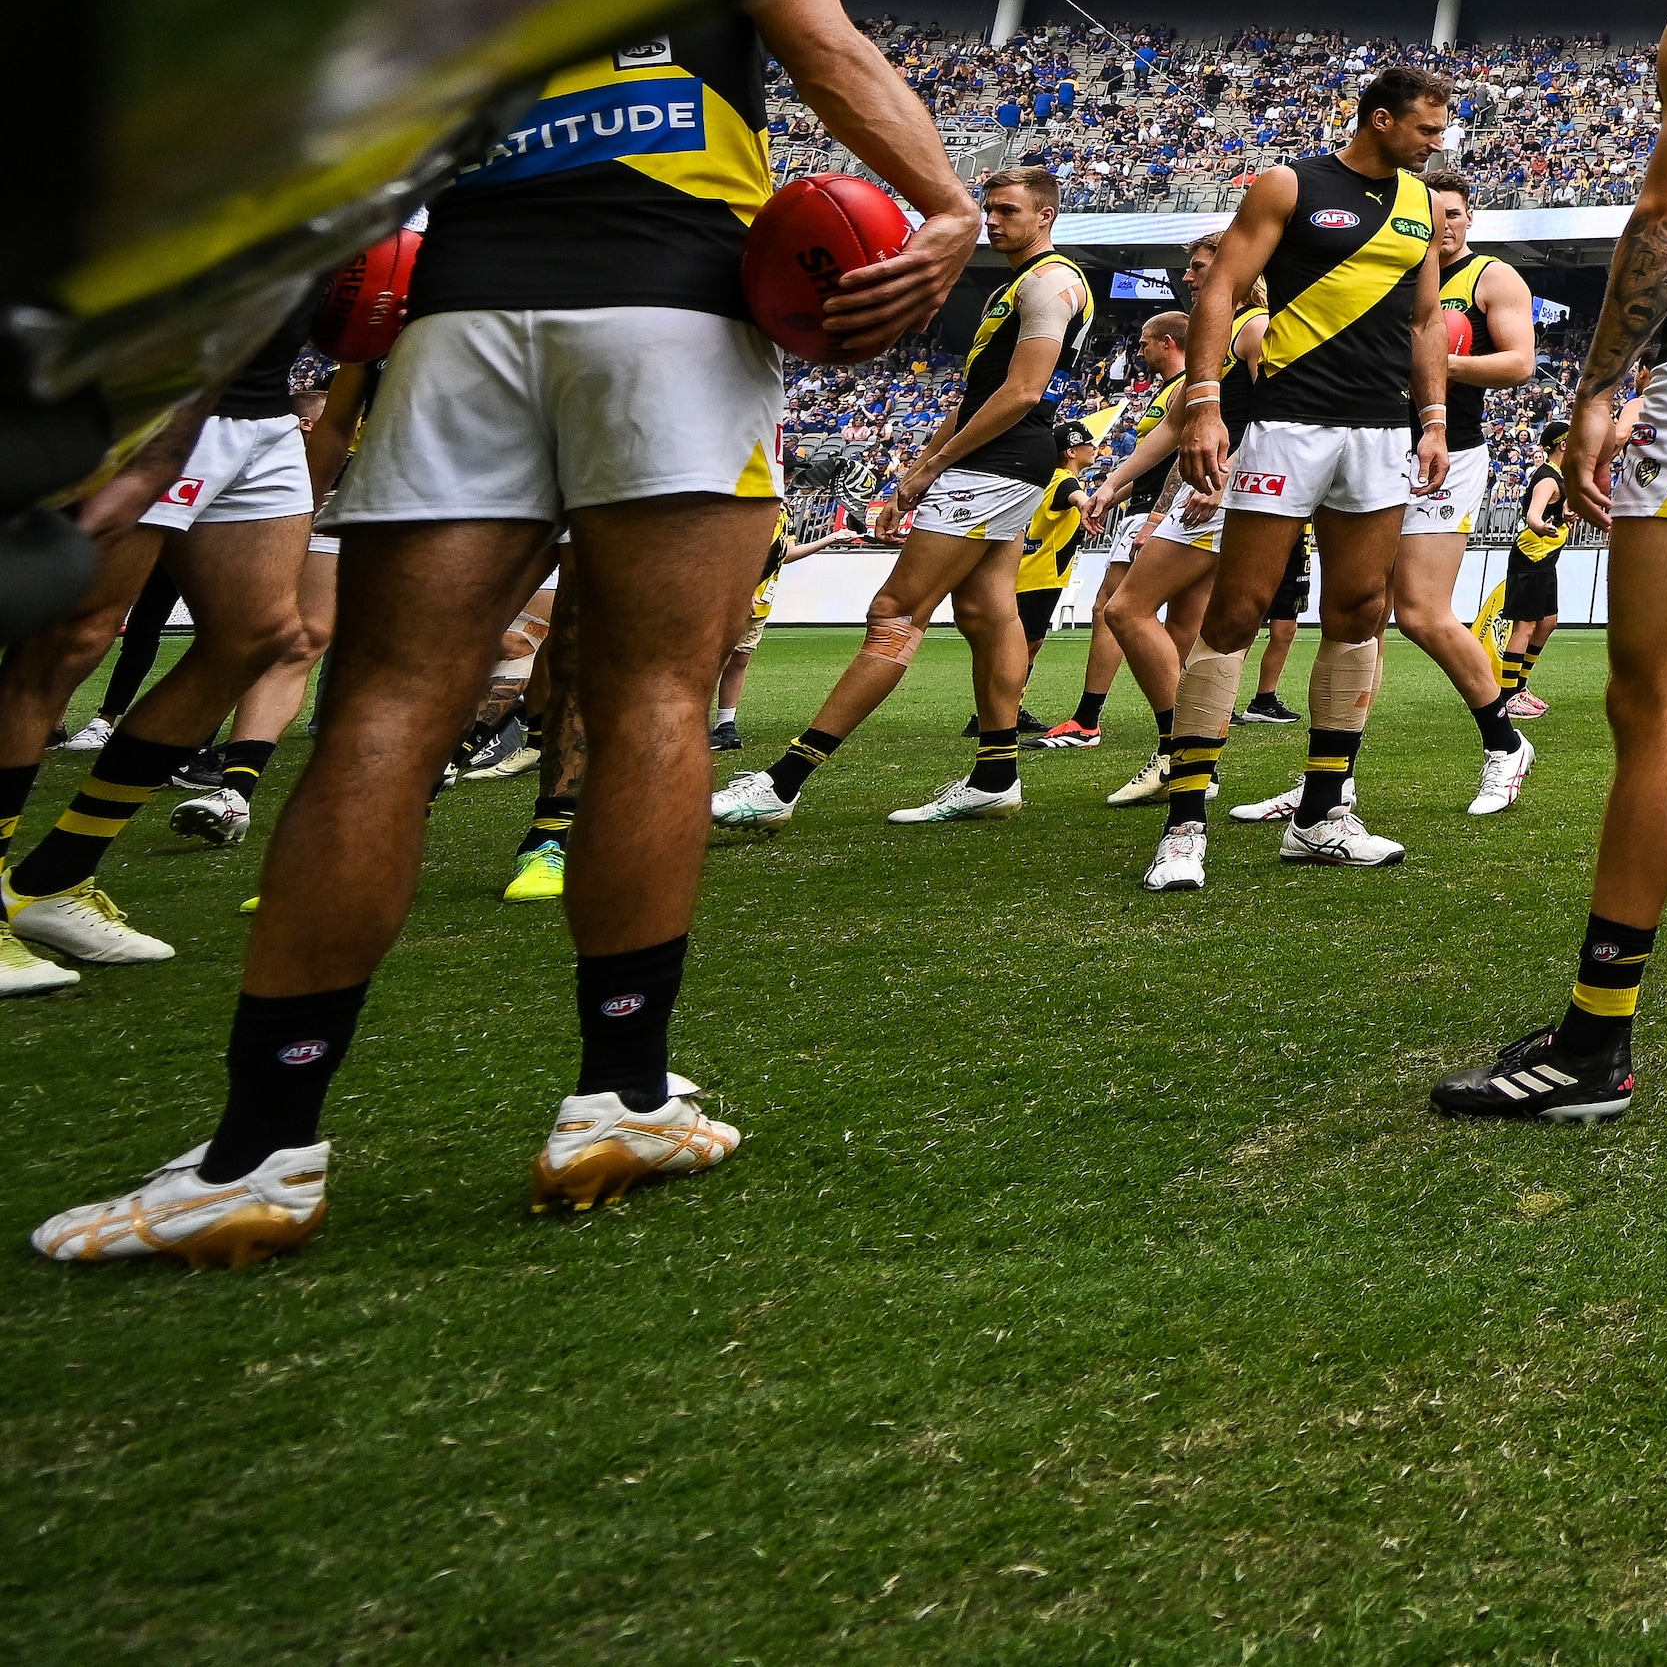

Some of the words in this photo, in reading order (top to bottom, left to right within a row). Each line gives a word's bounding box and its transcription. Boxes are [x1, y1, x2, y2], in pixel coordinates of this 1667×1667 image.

[1316, 212, 1357, 225] AFL
[1232, 470, 1282, 495] KFC
[1594, 946, 1616, 955] AFL
[606, 998, 640, 1011] AFL
[282, 1045, 322, 1057] AFL
